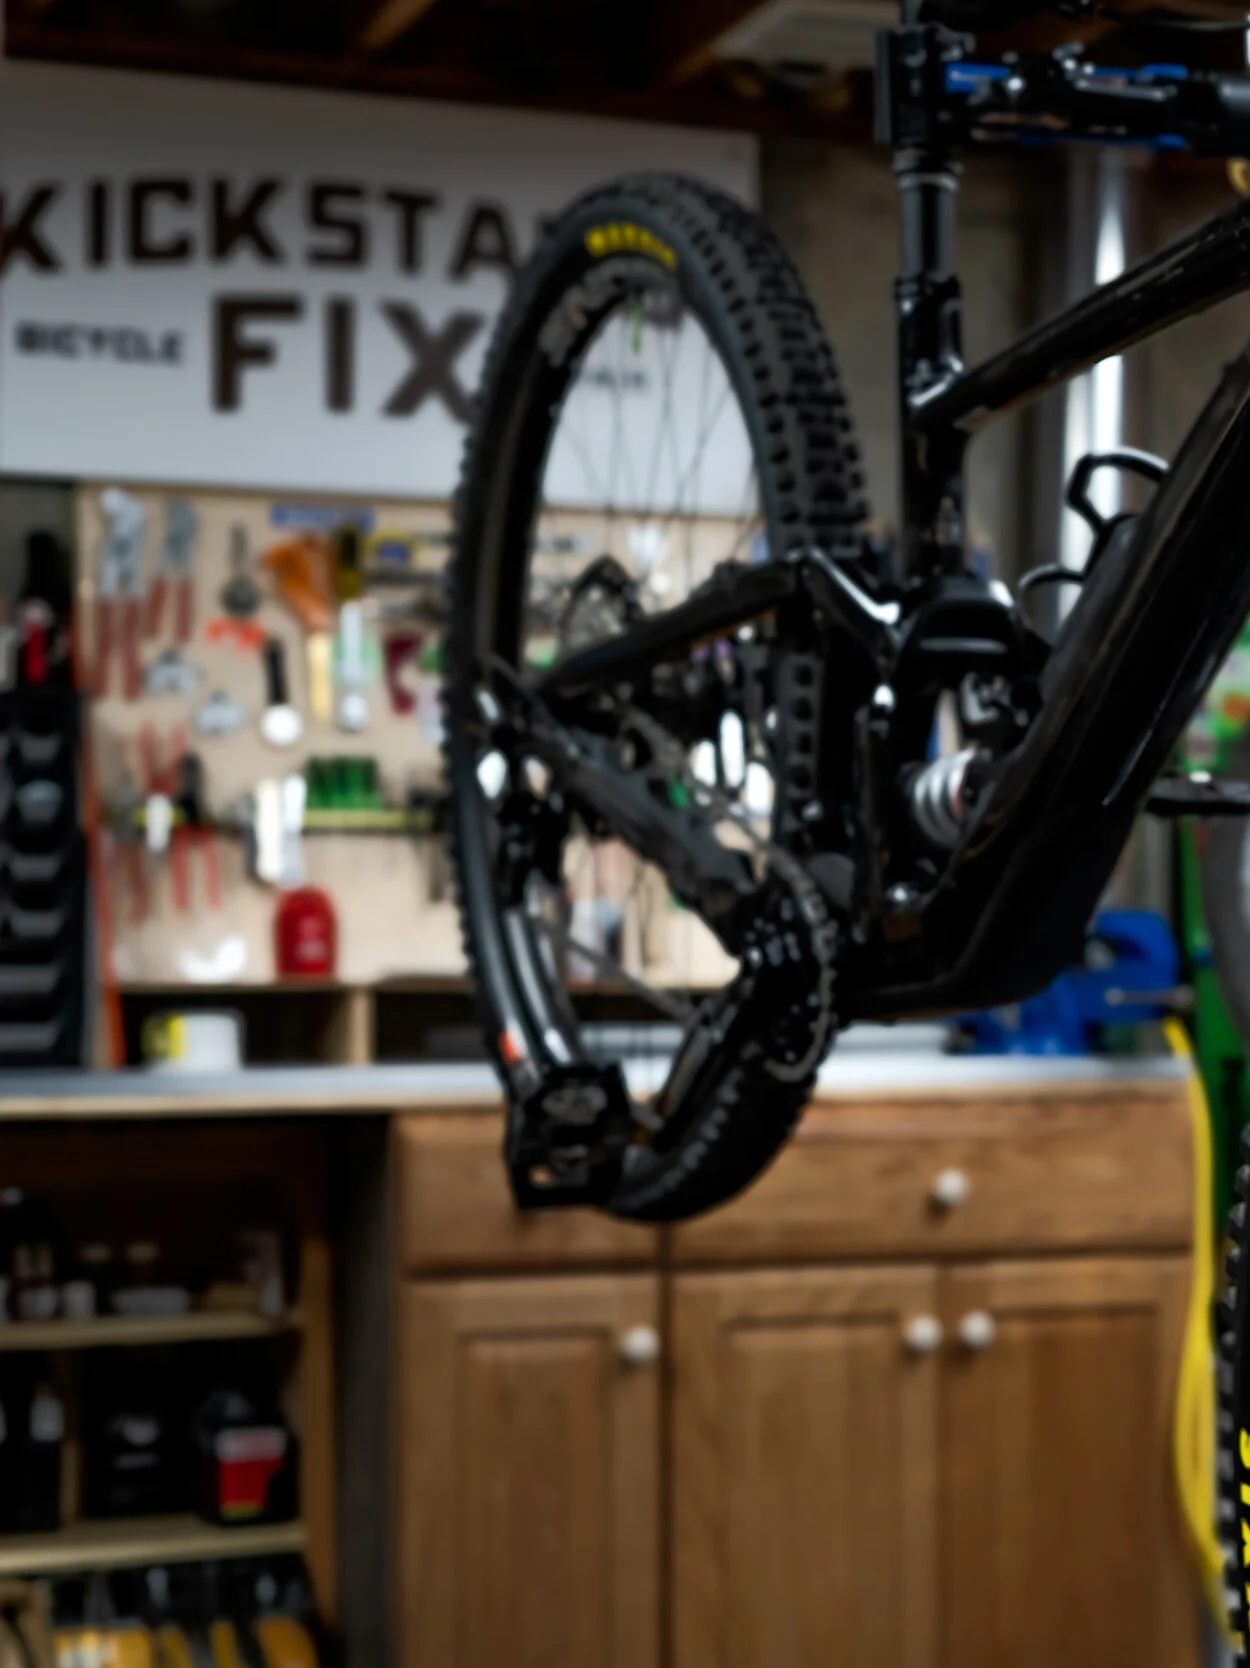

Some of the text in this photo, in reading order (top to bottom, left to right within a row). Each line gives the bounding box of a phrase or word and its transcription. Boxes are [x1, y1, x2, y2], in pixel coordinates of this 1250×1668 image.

[0, 178, 556, 283] KICKSTA
[15, 322, 184, 365] BICYCLE
[212, 295, 486, 424] FIX
